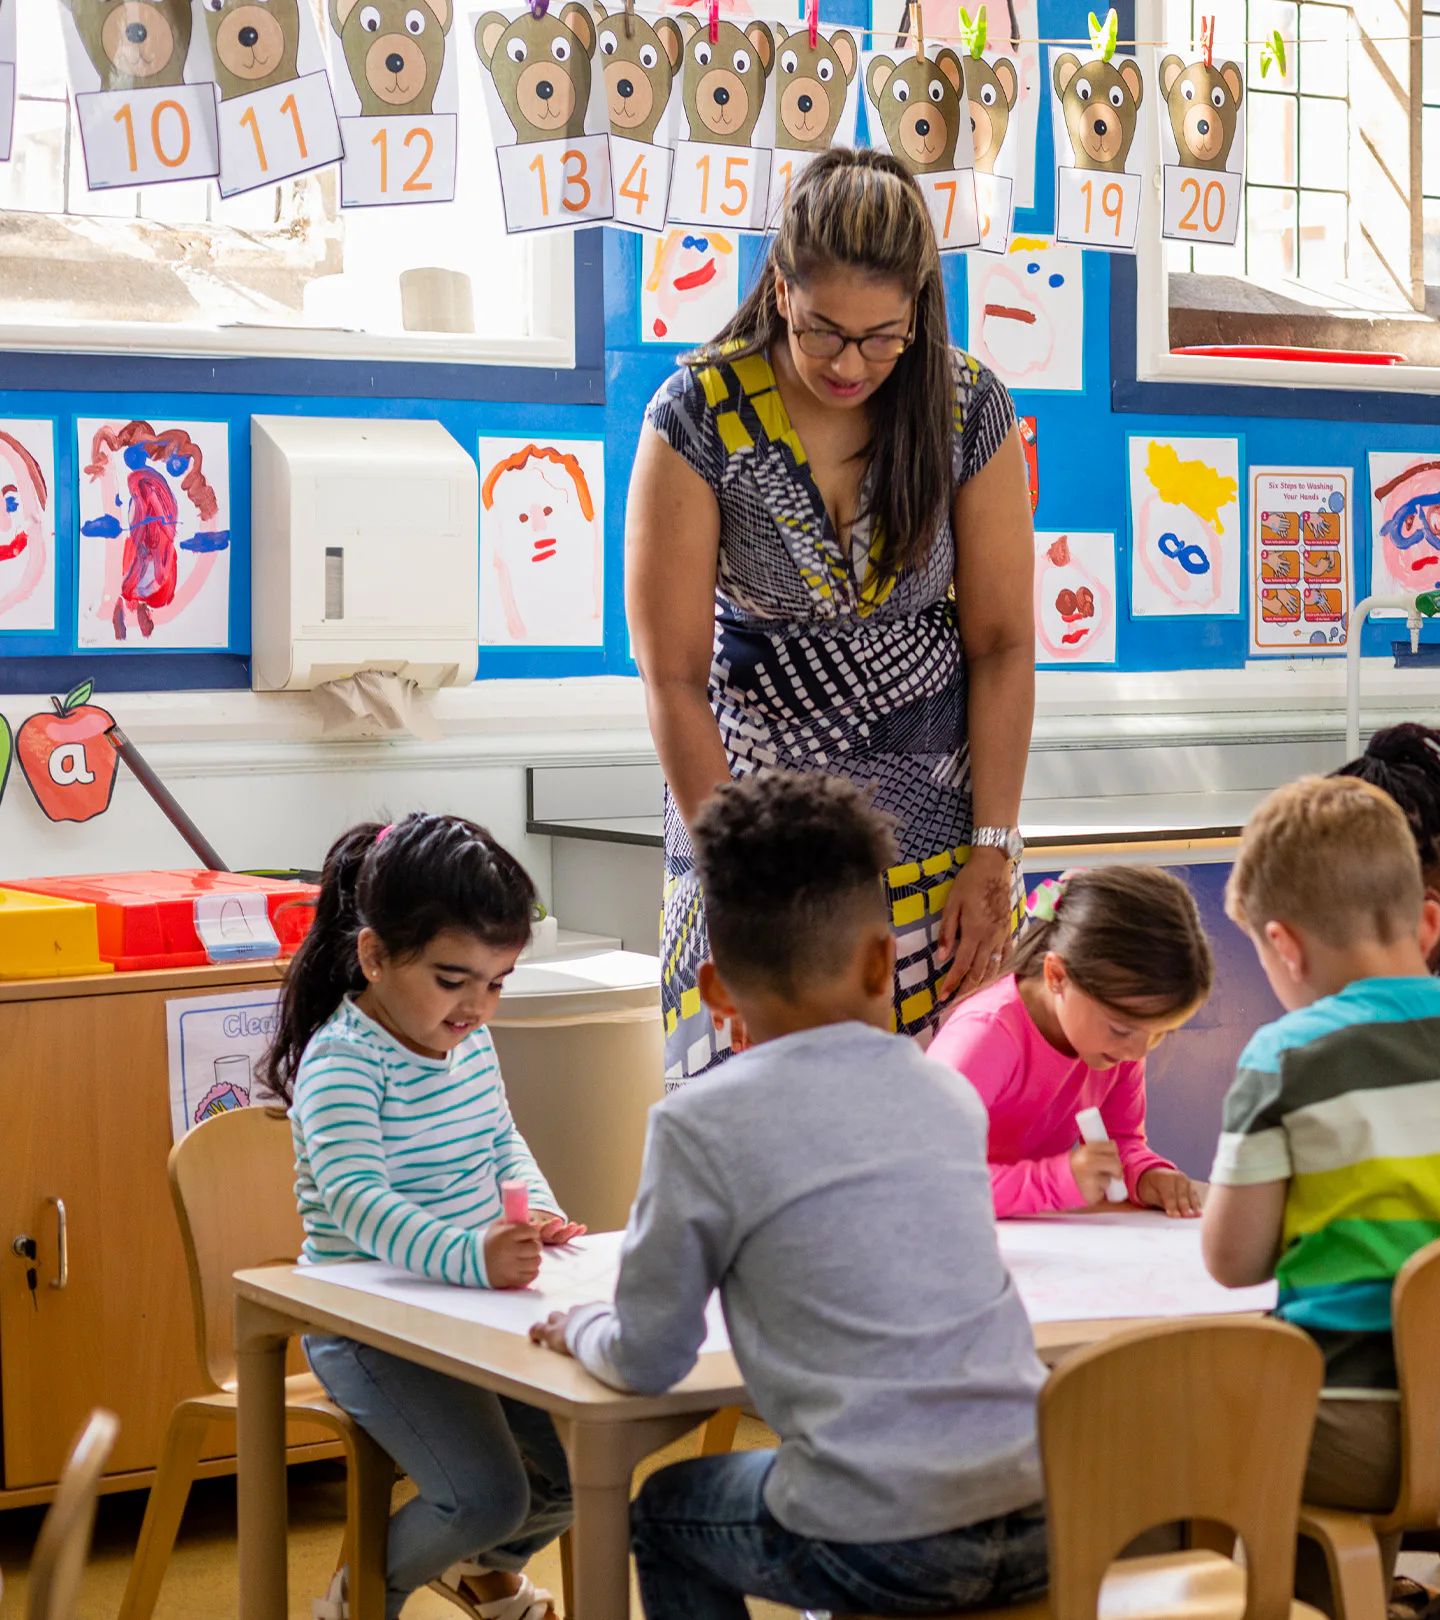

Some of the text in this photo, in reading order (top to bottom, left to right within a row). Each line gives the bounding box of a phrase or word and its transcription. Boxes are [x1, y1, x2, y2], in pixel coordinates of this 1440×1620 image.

[113, 100, 191, 172] 10
[239, 93, 308, 172] 11
[371, 127, 434, 193] 12
[529, 150, 591, 216] 13
[619, 154, 649, 215] 4
[696, 154, 749, 216] 15
[779, 161, 793, 209] 1
[934, 180, 957, 239] 7
[1080, 179, 1124, 237] 19
[1178, 178, 1226, 232] 20
[1280, 482, 1297, 491] Steps
[1307, 483, 1334, 492] Washing
[48, 742, 96, 786] a
[223, 1011, 278, 1038] Clea
